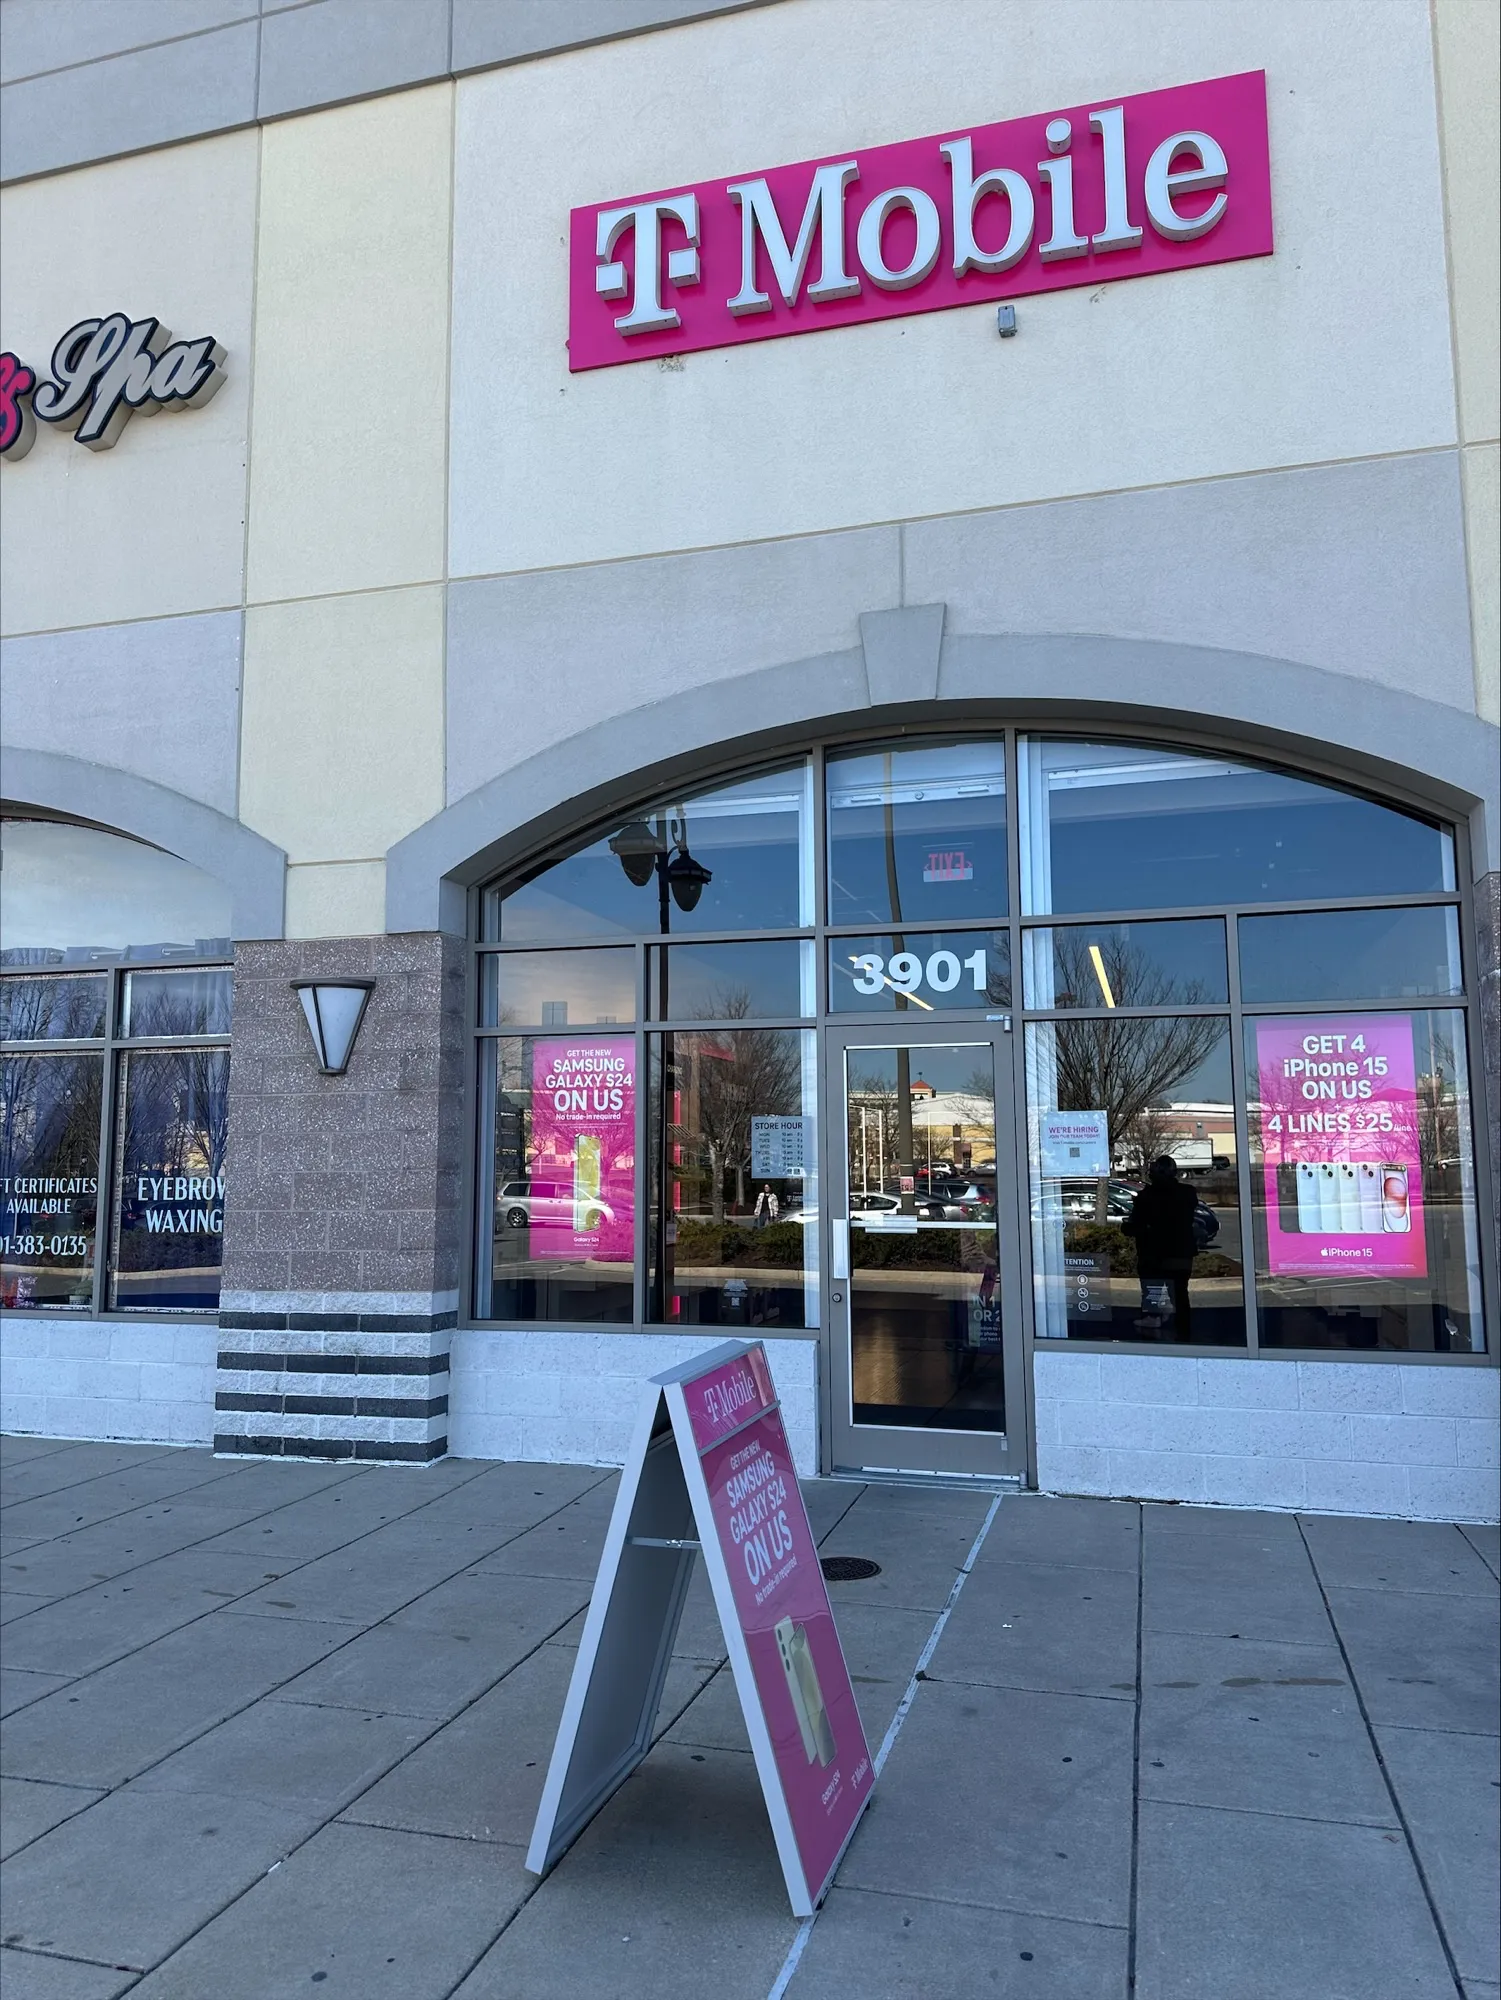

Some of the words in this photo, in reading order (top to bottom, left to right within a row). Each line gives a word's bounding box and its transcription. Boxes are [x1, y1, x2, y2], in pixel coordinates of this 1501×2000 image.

[32, 312, 222, 448] Spa
[853, 950, 987, 995] 3901
[581, 1049, 594, 1057] THE
[595, 1048, 611, 1056] NEW
[1302, 1035, 1347, 1055] GET
[1350, 1034, 1366, 1053] 4
[553, 1057, 625, 1073] SAMSUNG
[1283, 1057, 1359, 1077] iPhone
[1363, 1056, 1389, 1076] 15
[545, 1073, 603, 1088] GALAXY
[605, 1073, 632, 1088] S24
[1302, 1081, 1336, 1100] ON
[1342, 1079, 1372, 1099] US
[554, 1089, 588, 1112] ON
[593, 1088, 624, 1111] US
[593, 1112, 621, 1121] required
[754, 1122, 779, 1130] STORE
[1267, 1114, 1283, 1133] 4
[1288, 1113, 1351, 1133] LINES
[1048, 1126, 1072, 1134] WE'RE
[1073, 1126, 1099, 1134] HIRING
[14, 1177, 98, 1194] CERTIFICATES
[6, 1198, 72, 1214] AVAILABLE
[145, 1208, 223, 1234] WAXING
[1064, 1258, 1095, 1266] TENTION
[1328, 1247, 1361, 1257] iPhone
[1362, 1248, 1373, 1257] 15
[973, 1309, 992, 1322] OR
[730, 1453, 741, 1470] GET
[739, 1447, 750, 1463] THE
[748, 1438, 761, 1457] NEW
[726, 1451, 775, 1508] SAMSUNG
[730, 1489, 769, 1545] GALAXY
[767, 1476, 787, 1511] S24
[744, 1529, 772, 1586] ON
[768, 1510, 793, 1560] US
[755, 1591, 764, 1606] No
[778, 1552, 798, 1580] required
